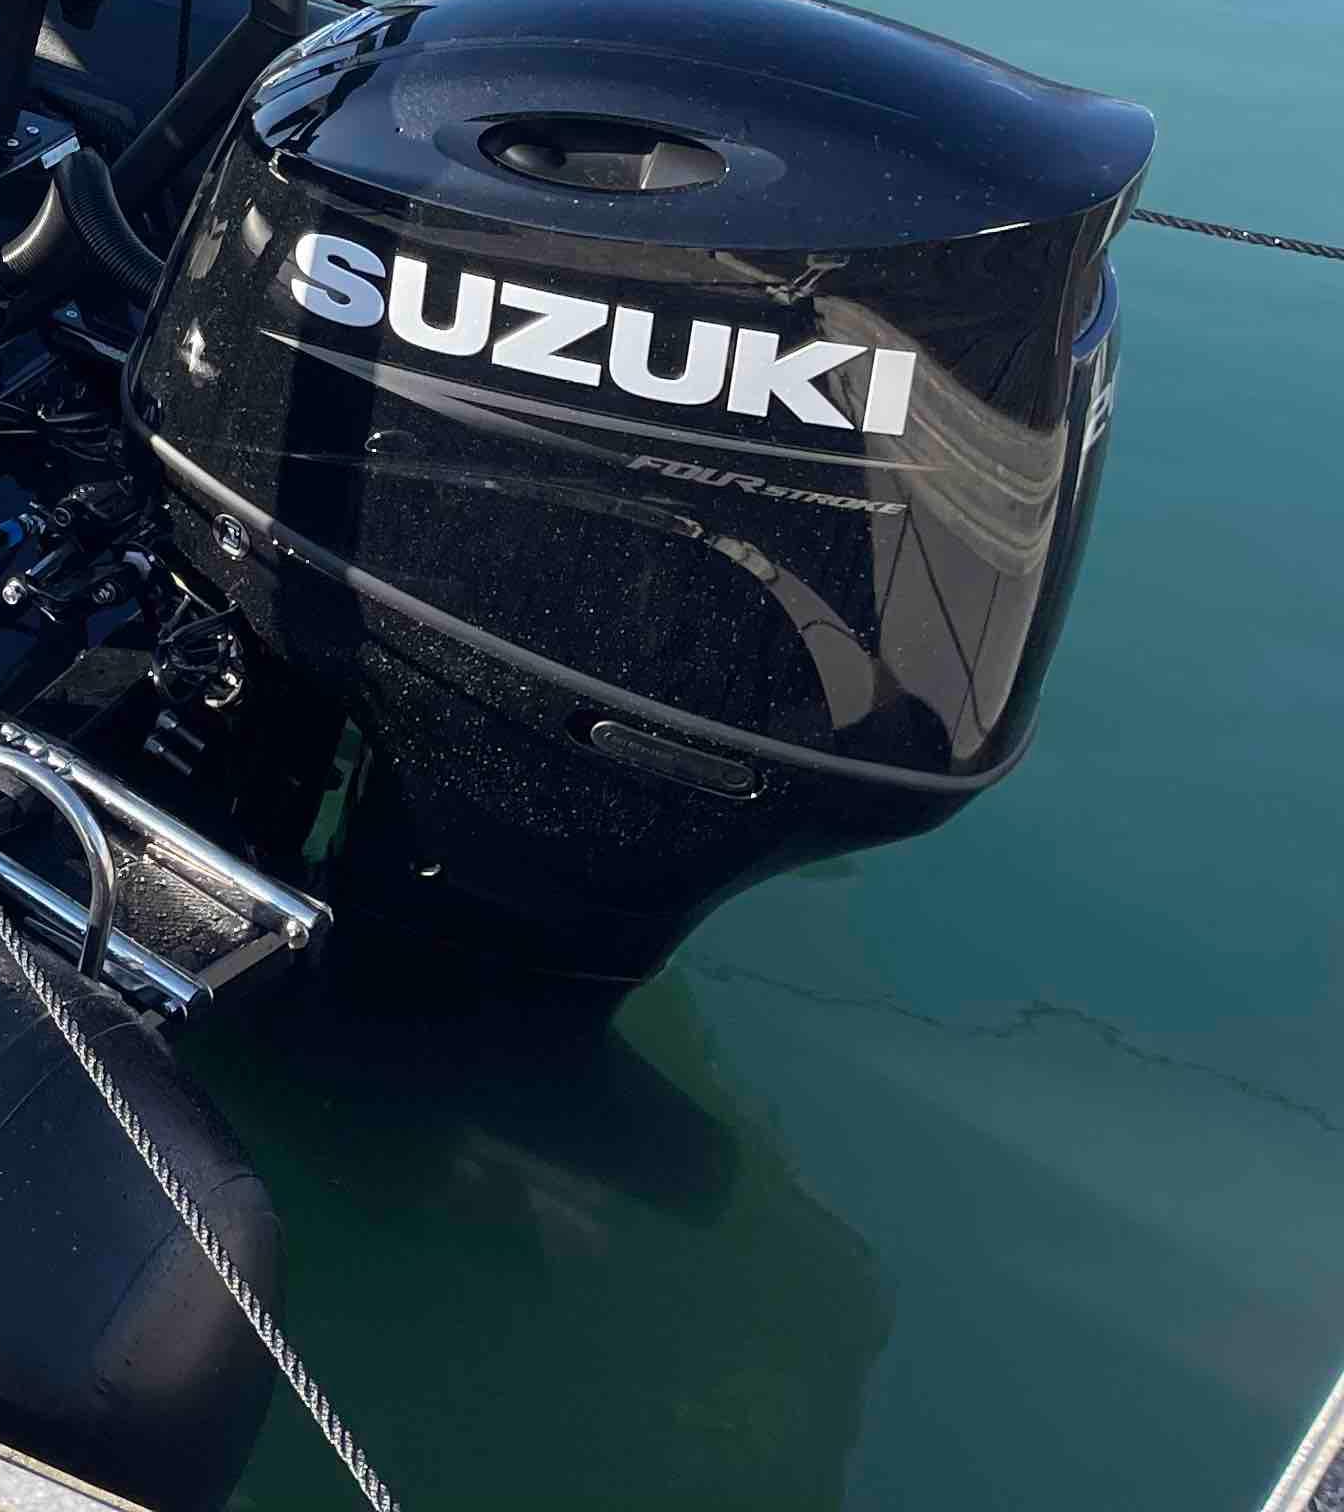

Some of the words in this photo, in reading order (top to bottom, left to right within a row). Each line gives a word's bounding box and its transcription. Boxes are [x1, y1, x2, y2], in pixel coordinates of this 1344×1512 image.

[290, 232, 917, 436] SUZUKI
[626, 455, 766, 494] FOUR
[760, 485, 909, 515] STROKE
